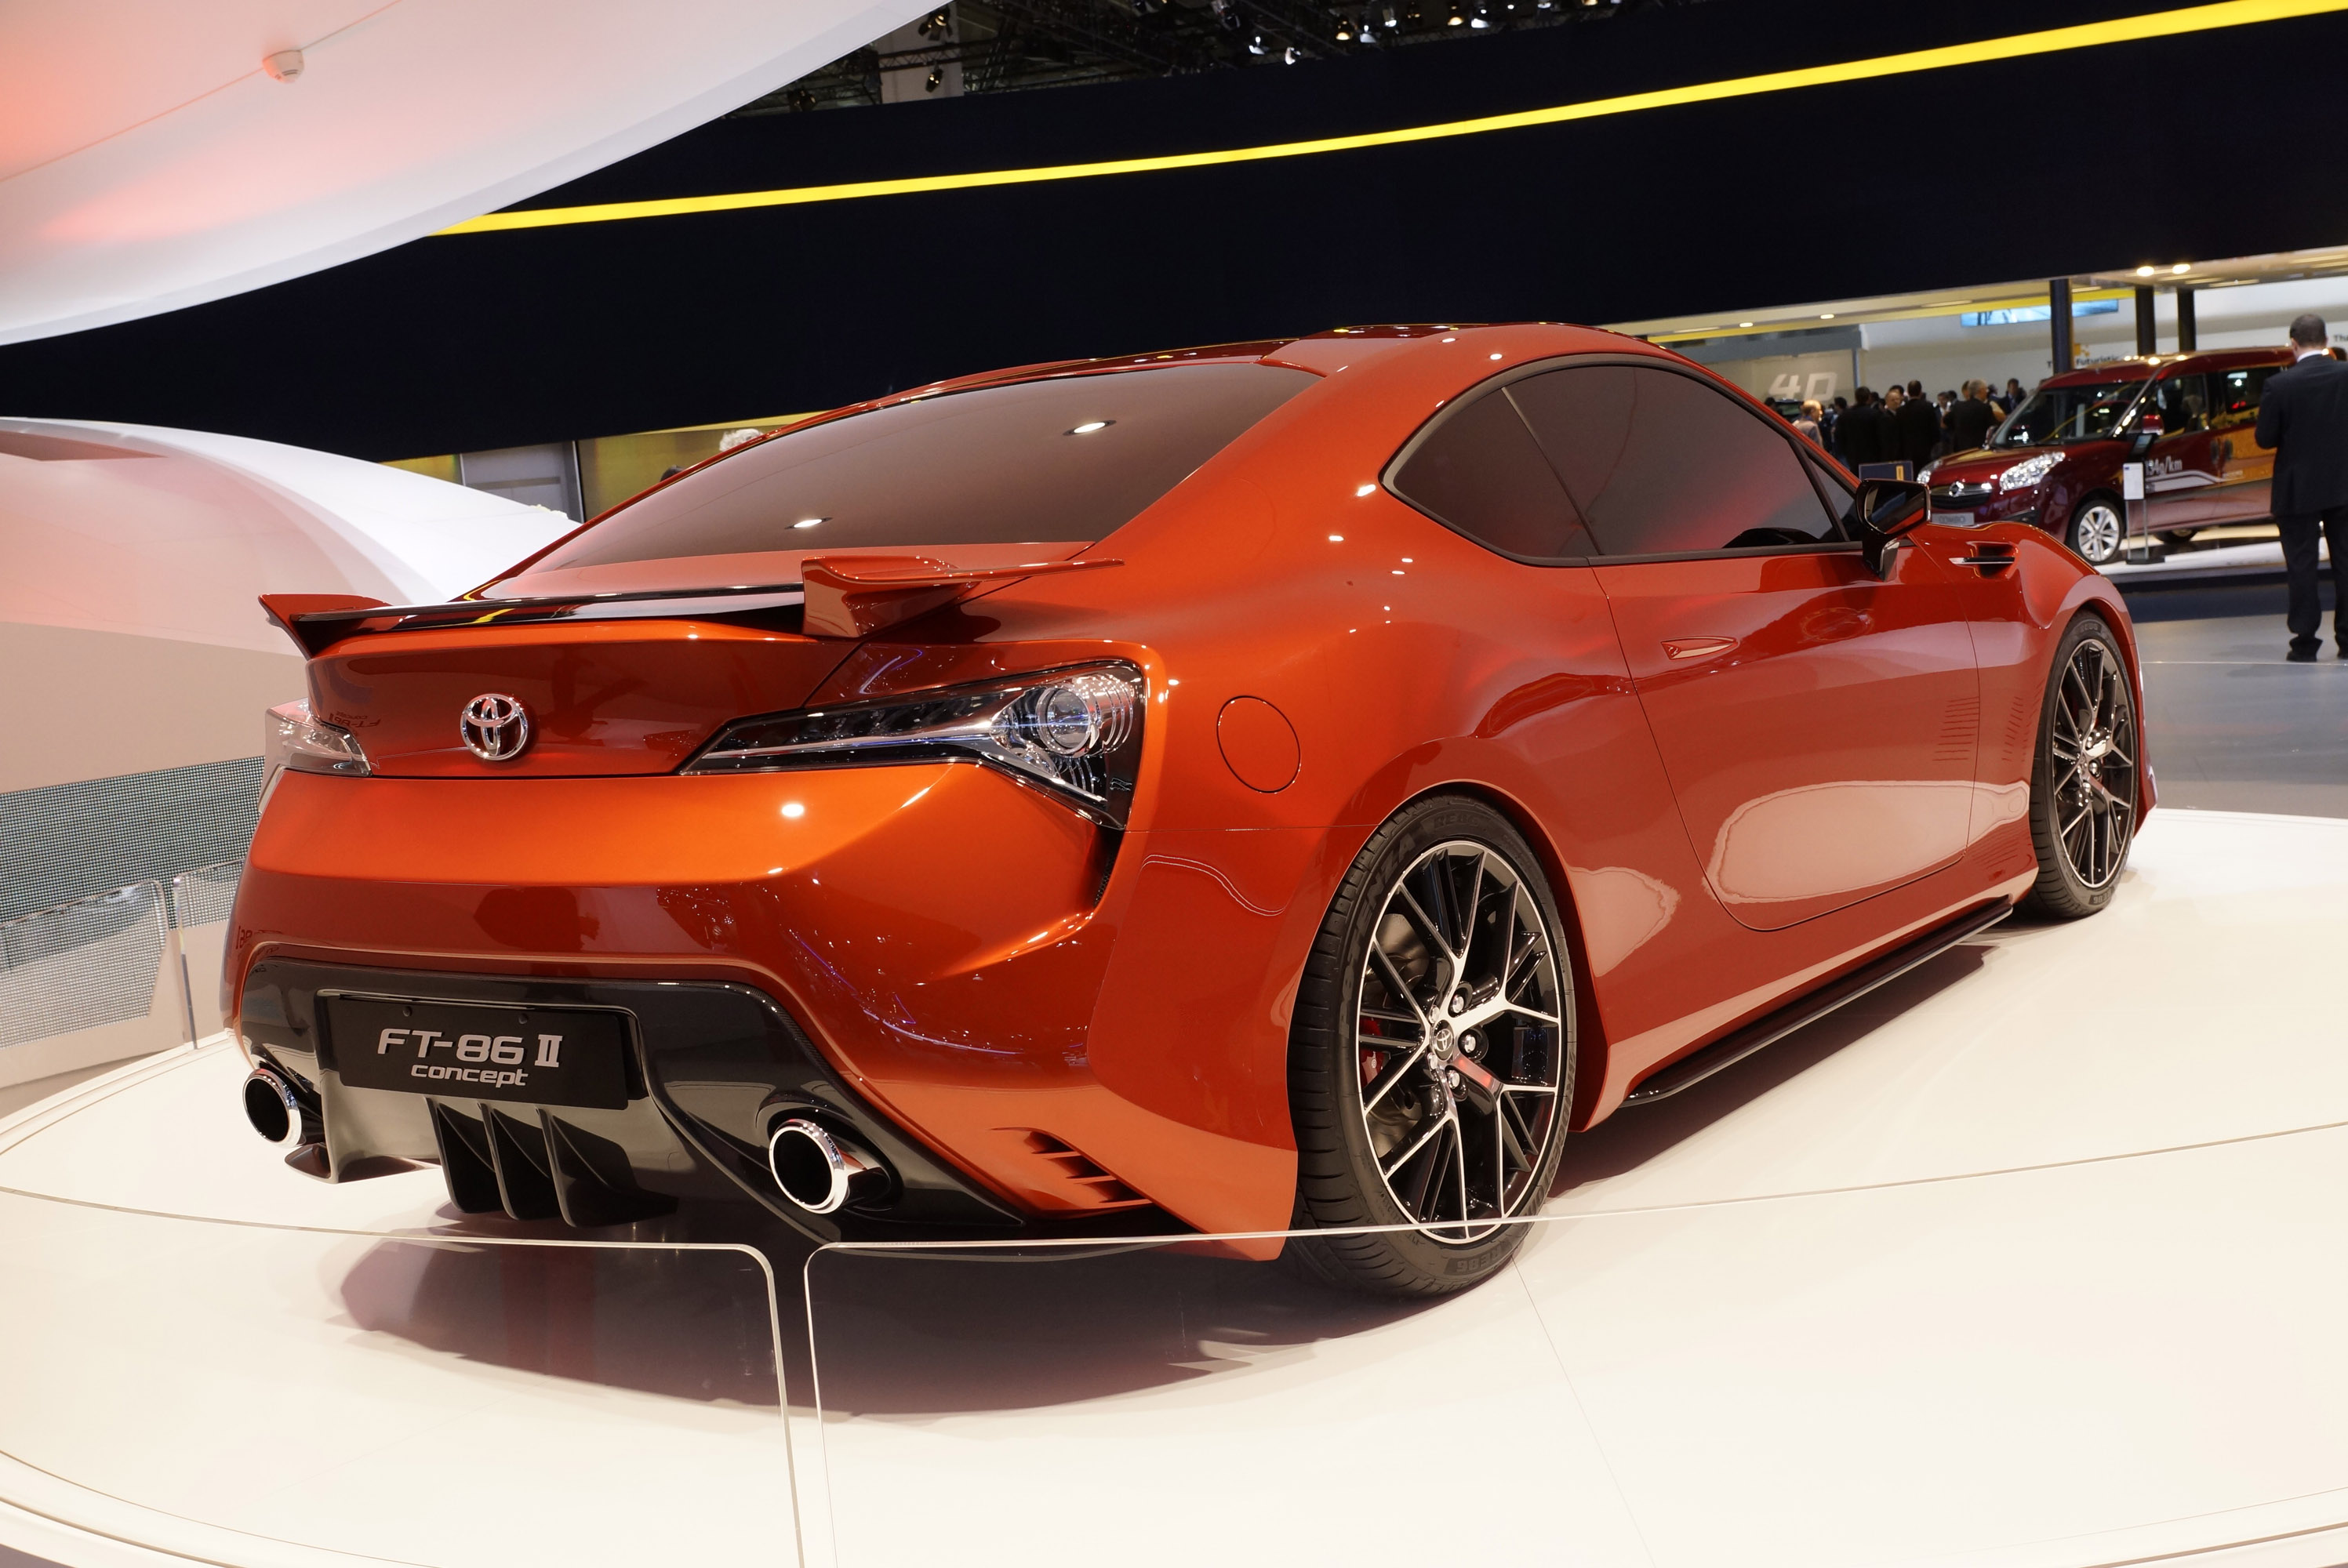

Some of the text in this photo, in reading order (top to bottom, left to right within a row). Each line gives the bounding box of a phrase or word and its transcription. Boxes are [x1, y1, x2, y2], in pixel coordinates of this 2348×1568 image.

[1768, 372, 1837, 401] 4D
[377, 1028, 563, 1068] FT-86 II
[411, 1064, 529, 1088] concept
